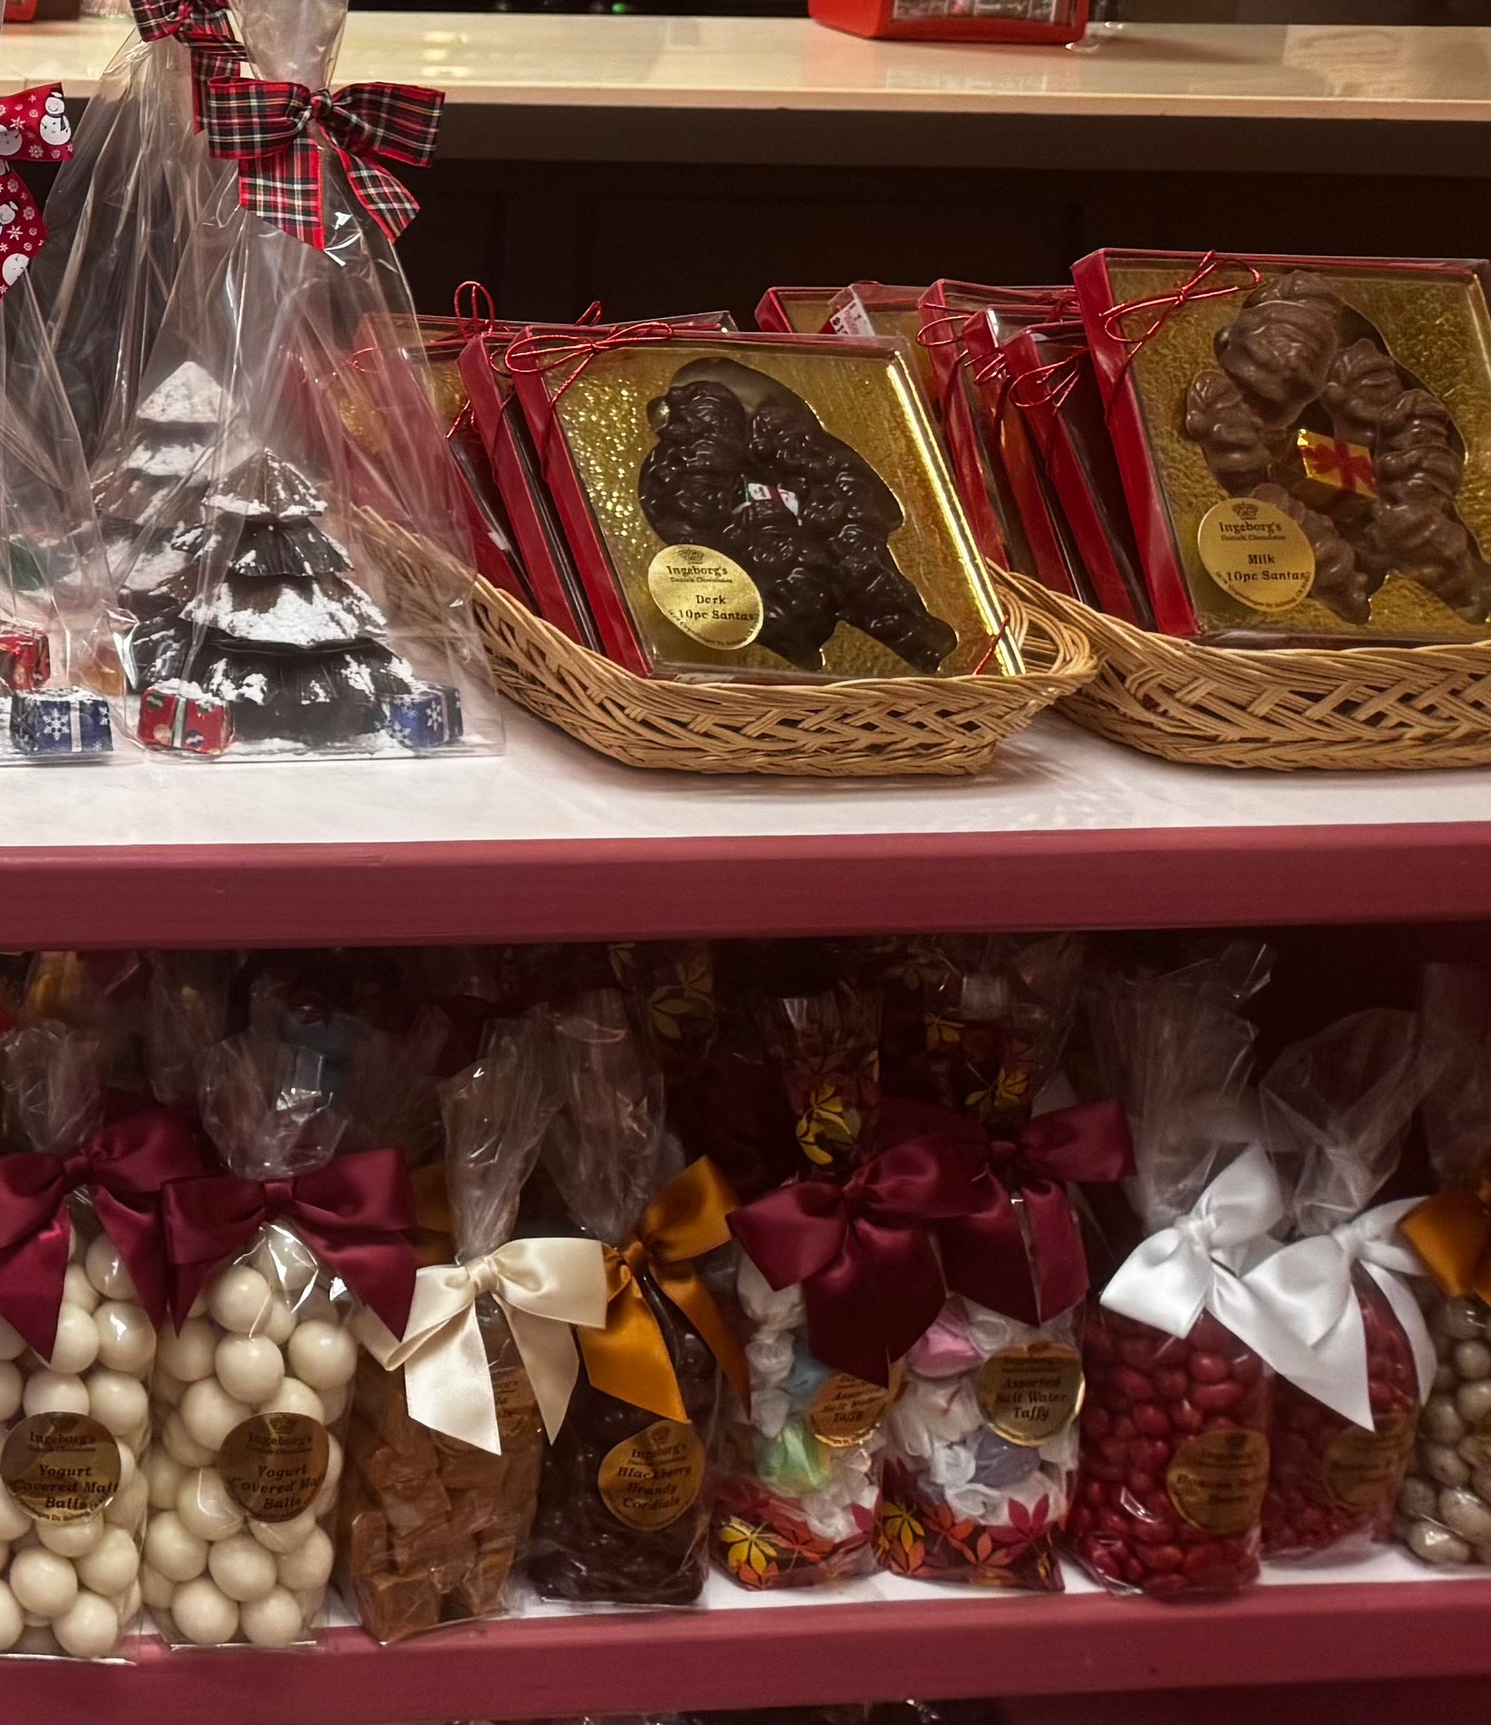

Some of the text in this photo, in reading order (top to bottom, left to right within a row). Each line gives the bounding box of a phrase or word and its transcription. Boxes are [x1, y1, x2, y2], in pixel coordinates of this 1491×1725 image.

[1219, 521, 1282, 533] Ingeborg's
[1248, 554, 1275, 564] Milk
[666, 565, 728, 577] Ingeborg's
[1227, 571, 1258, 582] 10pc
[679, 609, 708, 620] 10pc
[1027, 1391, 1068, 1403] Water
[1013, 1406, 1050, 1421] Taffy
[39, 1463, 92, 1478] Yogurt
[257, 1464, 307, 1481] Yogurt
[617, 1465, 692, 1480] Blackberry
[44, 1496, 87, 1510] Balls
